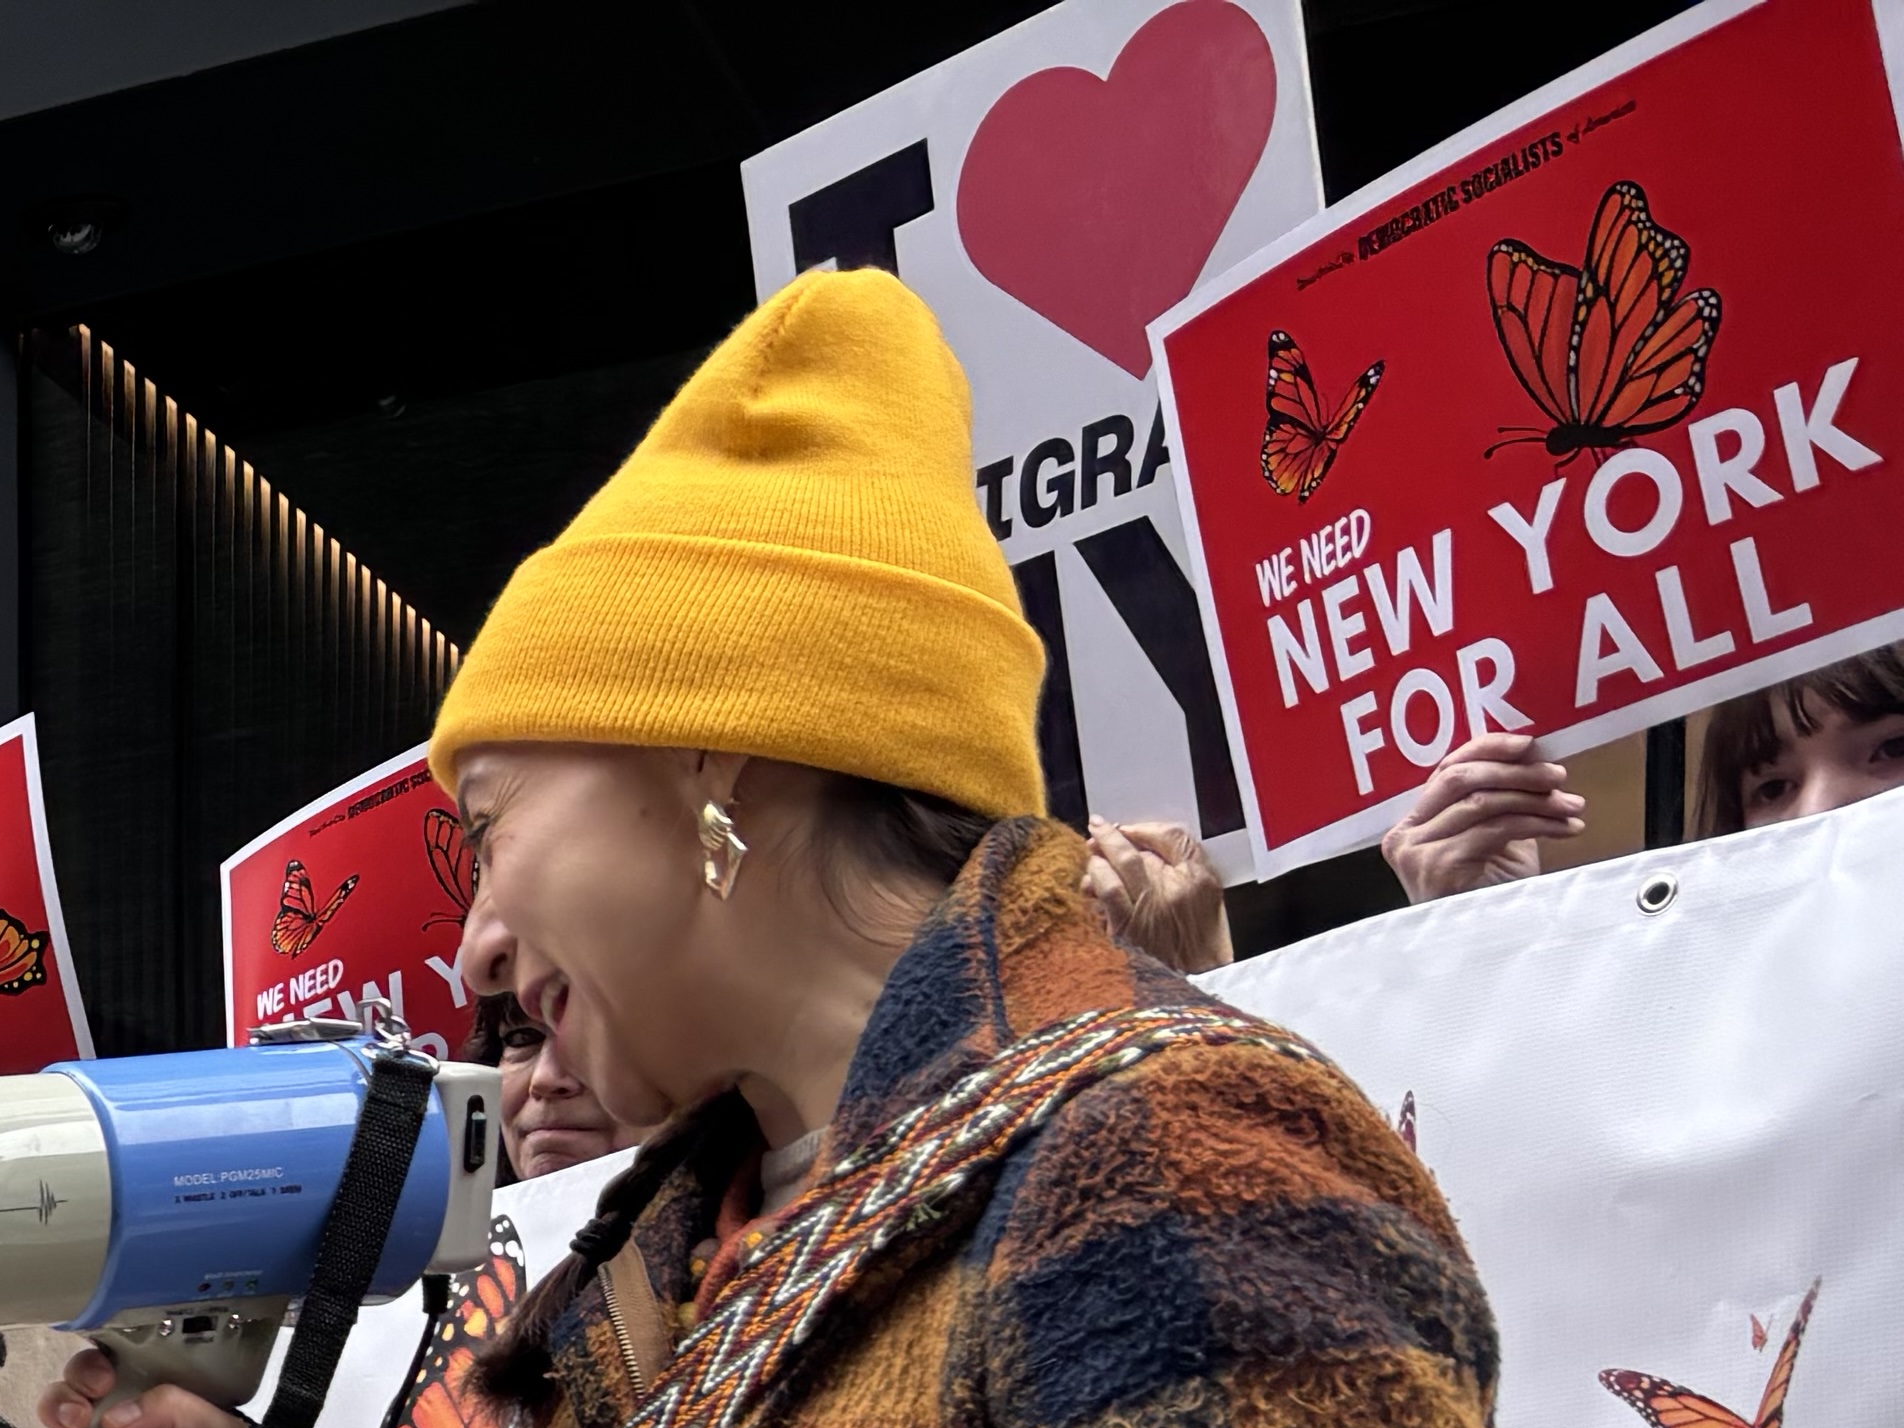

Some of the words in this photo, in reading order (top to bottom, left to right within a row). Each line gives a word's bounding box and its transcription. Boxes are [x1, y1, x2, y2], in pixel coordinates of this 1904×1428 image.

[1256, 551, 1297, 607] WE
[1302, 508, 1372, 588] NEED
[1267, 528, 1455, 709] NEW
[1489, 356, 1884, 596] YORK
[1342, 637, 1535, 797] FOR
[1575, 537, 1814, 709] ALL
[257, 985, 284, 1020] WE
[290, 958, 344, 1005] NEED
